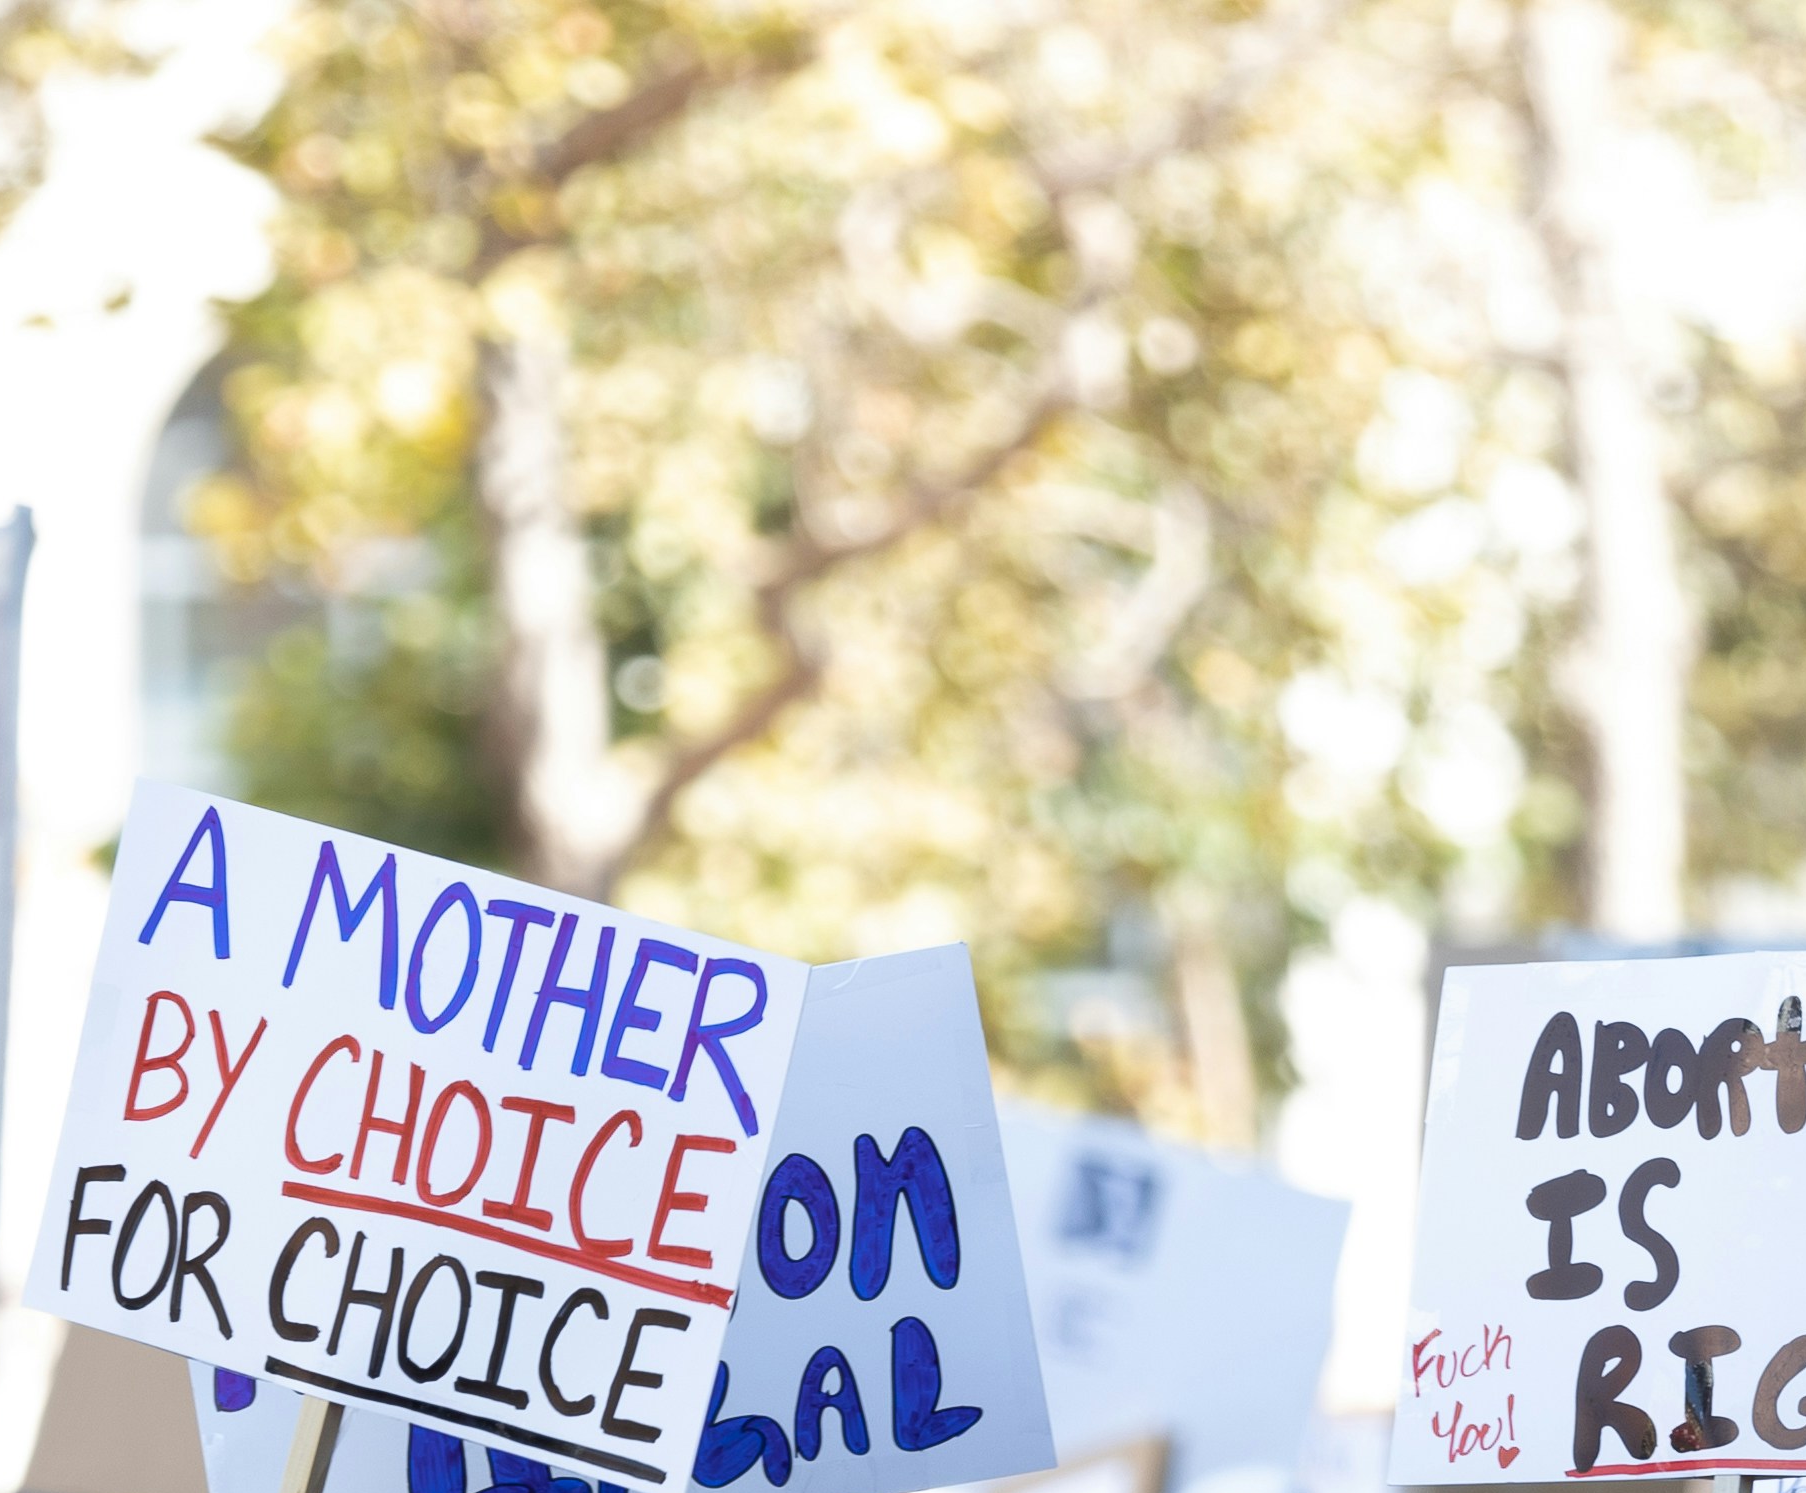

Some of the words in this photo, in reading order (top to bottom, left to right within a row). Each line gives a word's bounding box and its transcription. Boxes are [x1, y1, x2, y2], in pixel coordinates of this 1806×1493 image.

[139, 806, 229, 959] A
[283, 841, 767, 1137] MOTHER
[124, 991, 267, 1158] BY
[285, 1035, 737, 1269] CHOICE
[1526, 1157, 1681, 1311] IS
[62, 1165, 234, 1339] FOR
[268, 1218, 691, 1443] CHOICE
